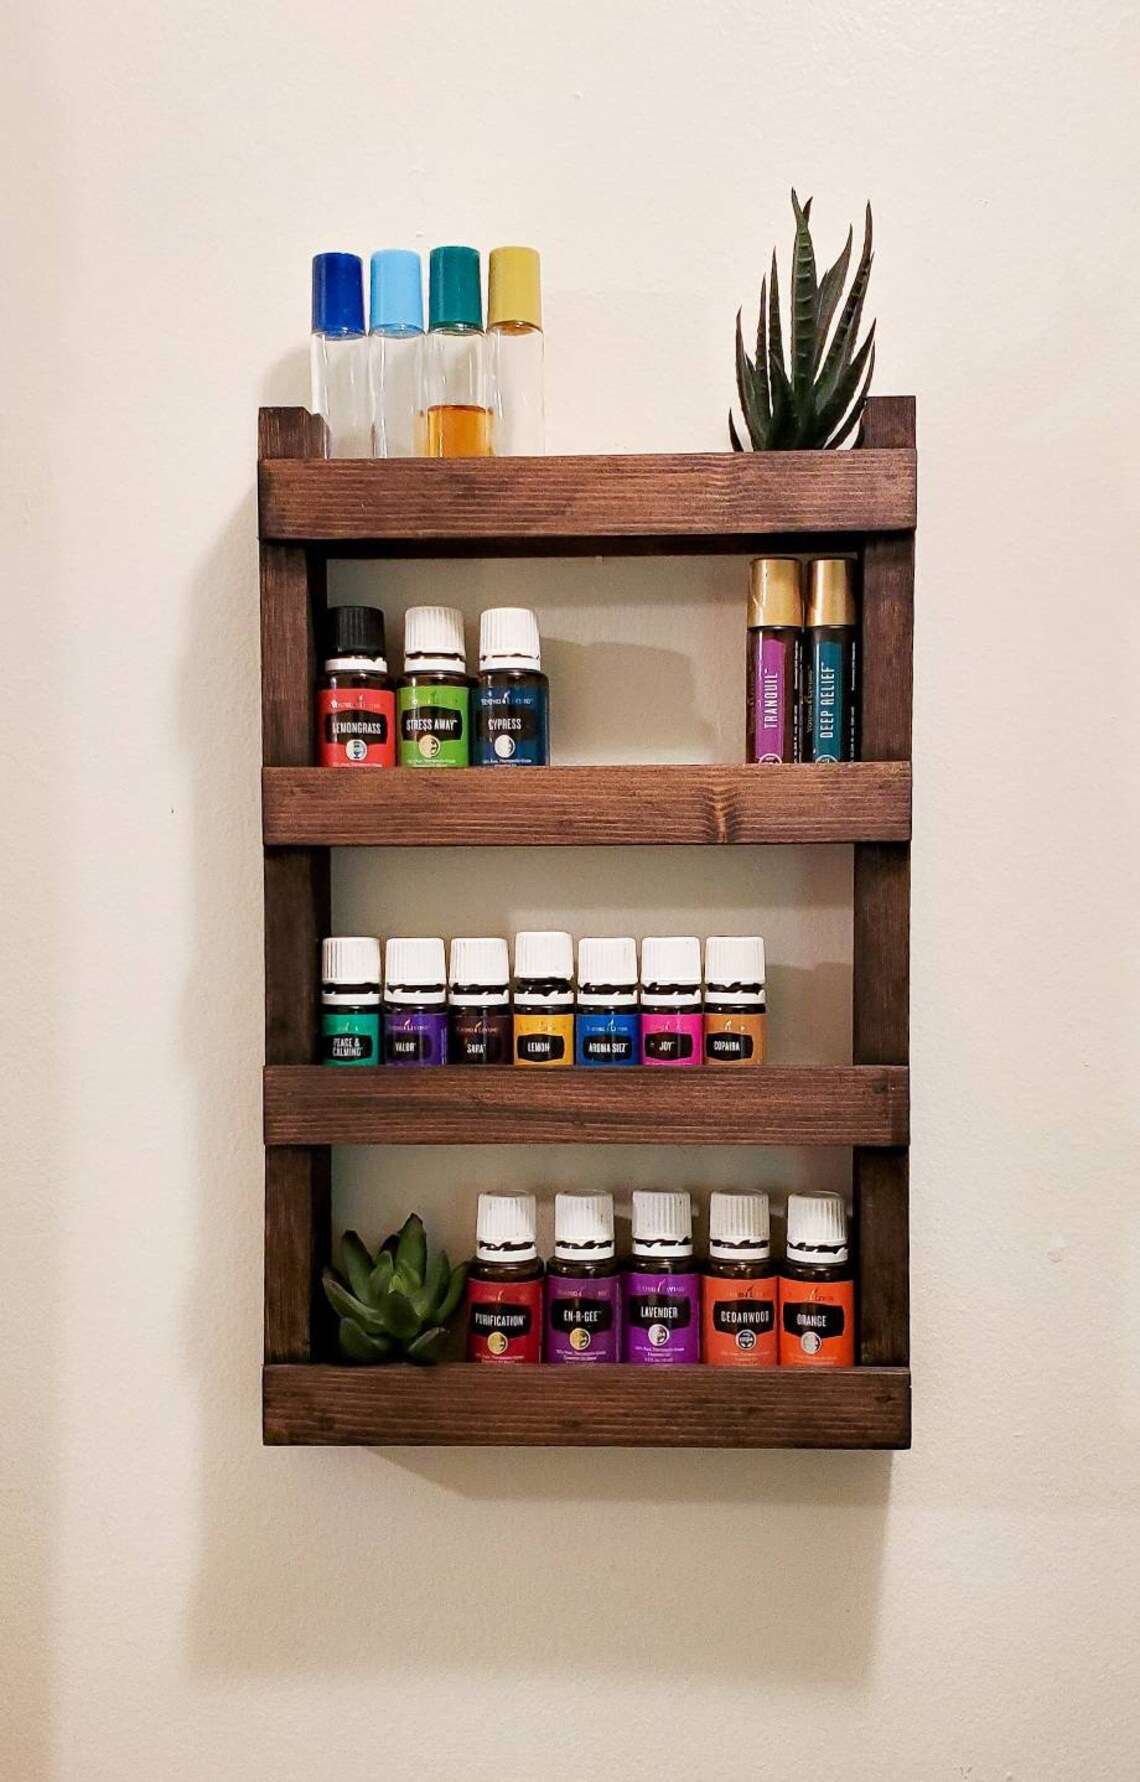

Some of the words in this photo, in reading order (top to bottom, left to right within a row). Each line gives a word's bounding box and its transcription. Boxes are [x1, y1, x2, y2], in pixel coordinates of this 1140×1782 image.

[820, 666, 835, 705] RELIEF
[764, 672, 778, 729] TRANQUIL
[332, 722, 381, 735] LEMONGRASS
[406, 719, 432, 732] STRESS
[434, 719, 455, 731] AWAY
[488, 718, 522, 731] CYPRESS
[820, 707, 834, 739] DEEP
[527, 1041, 551, 1053] LEMON
[588, 1042, 610, 1053] AROMA
[659, 1040, 672, 1051] JOY
[641, 1305, 679, 1318] LAVENDER
[720, 1310, 770, 1323] CEDARWOOD
[475, 1312, 524, 1327] PURIFICATION
[796, 1313, 827, 1327] ORANGE
